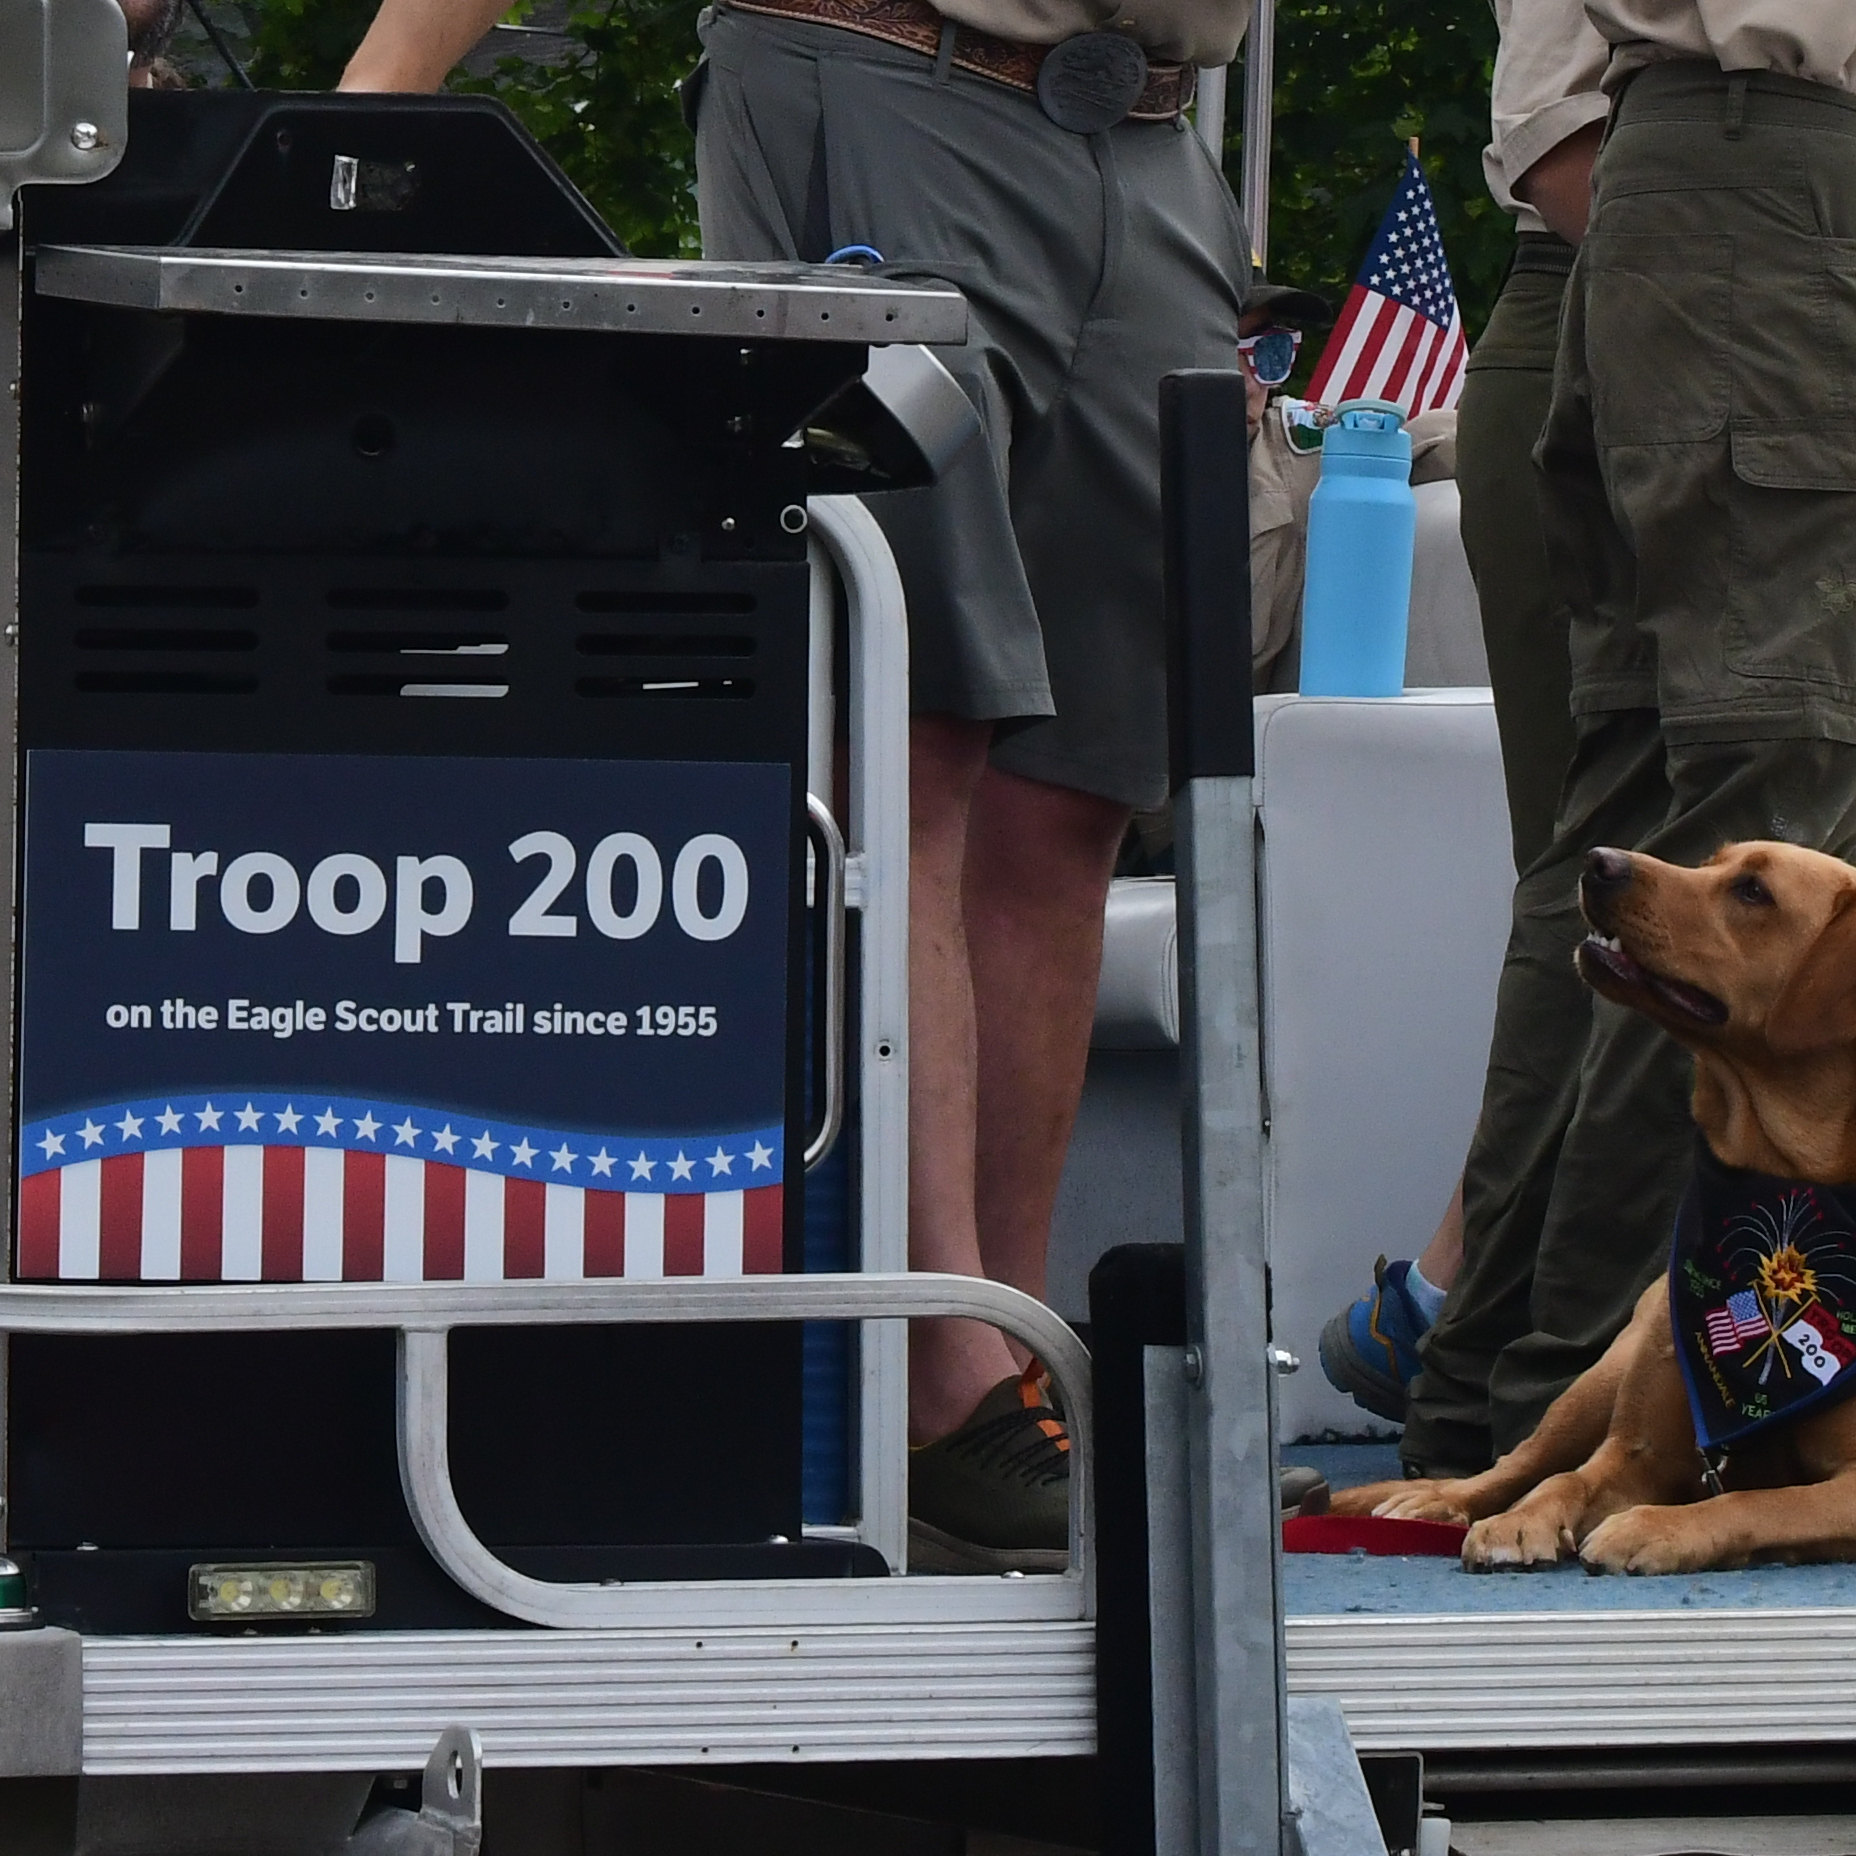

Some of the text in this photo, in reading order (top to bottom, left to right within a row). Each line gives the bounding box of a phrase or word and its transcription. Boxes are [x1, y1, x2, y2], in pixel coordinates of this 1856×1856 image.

[85, 823, 749, 964] Troop 200
[107, 998, 718, 1039] on the Eagle Scout Trail since 1955
[1798, 1334, 1826, 1368] 200
